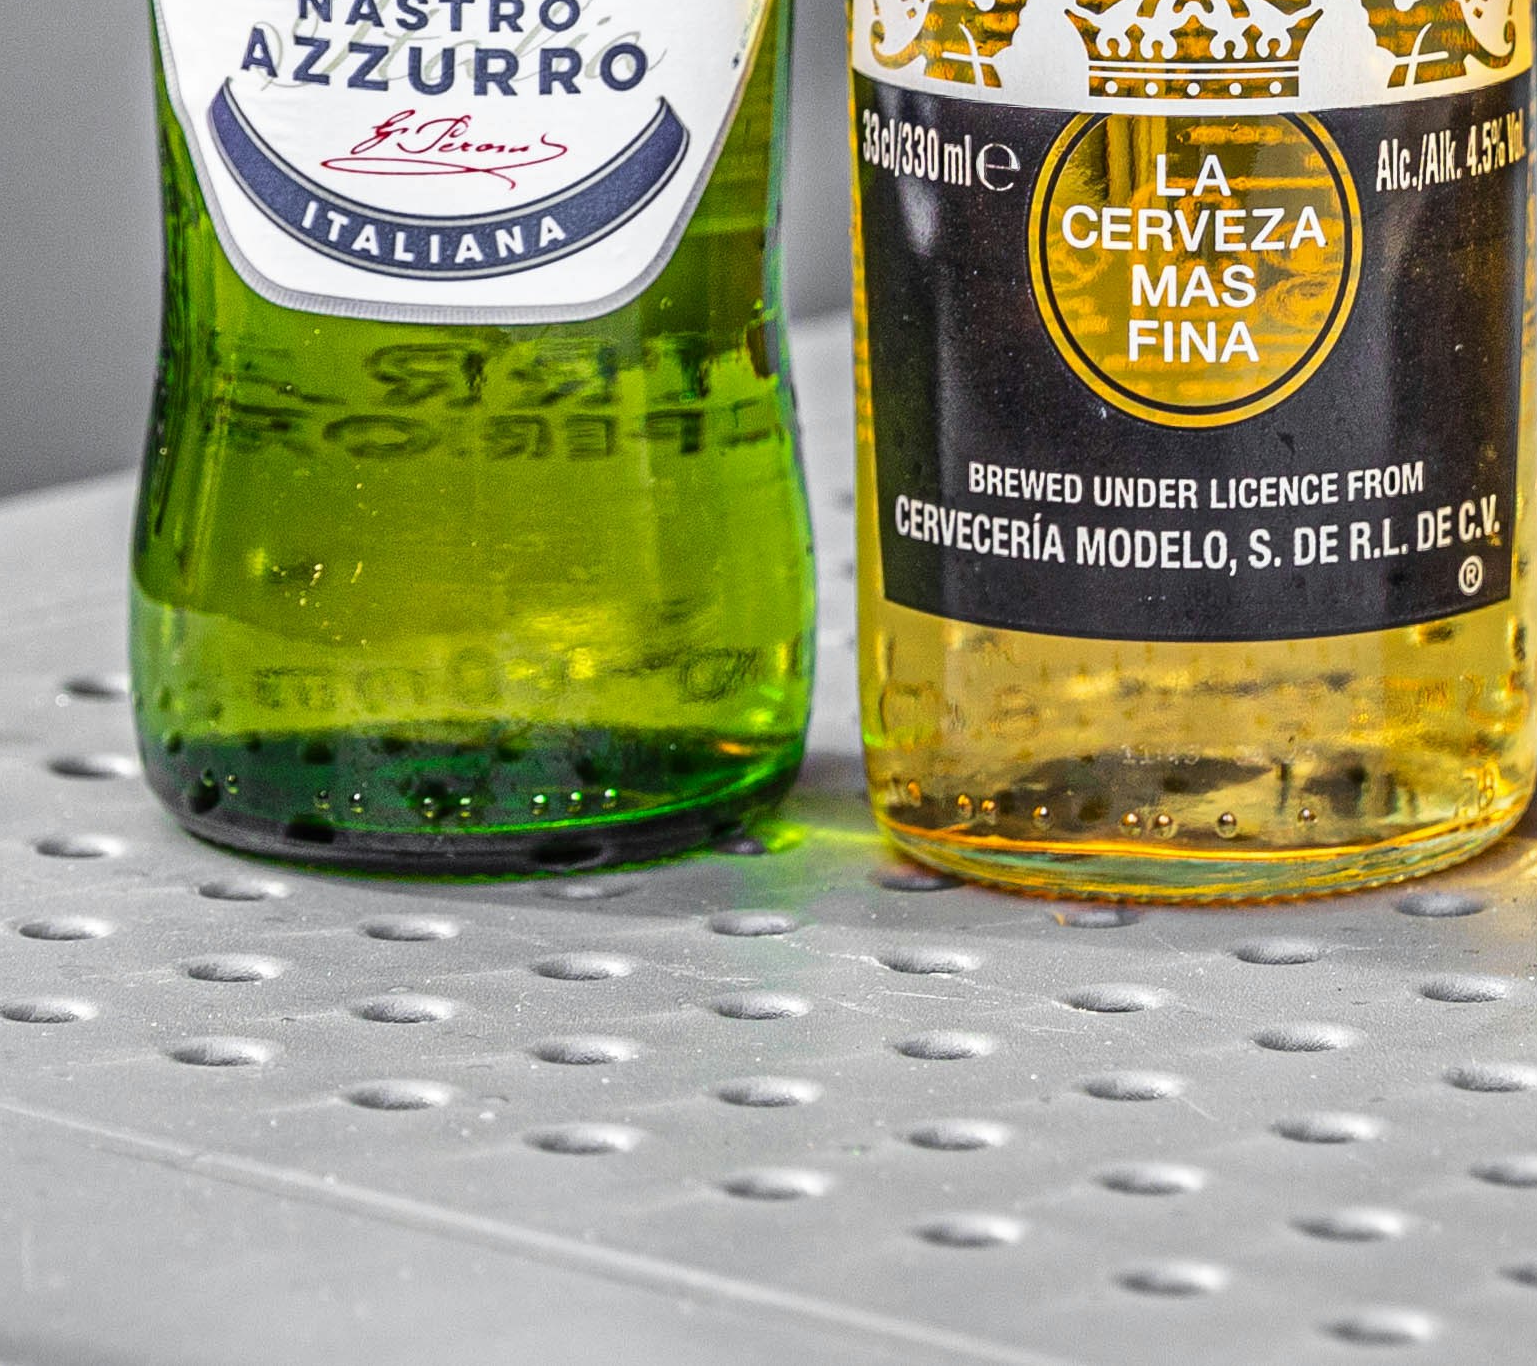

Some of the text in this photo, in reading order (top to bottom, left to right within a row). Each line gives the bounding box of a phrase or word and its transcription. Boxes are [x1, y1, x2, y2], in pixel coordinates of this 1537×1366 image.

[240, 26, 649, 97] AZZURRO
[1154, 153, 1231, 198] LA
[1375, 129, 1463, 192] Alc./Alk.
[1466, 116, 1506, 178] 4.5%
[299, 197, 566, 265] ITALIANA
[1061, 205, 1328, 252] CERVEZA
[1131, 264, 1257, 310] MAS
[1127, 319, 1260, 364] FINA
[968, 460, 1425, 510] BREWED UNDER LICENCE FROM
[894, 493, 1502, 577] CERVECERÍA MODELO, S. DE R.L. DE C.V.
